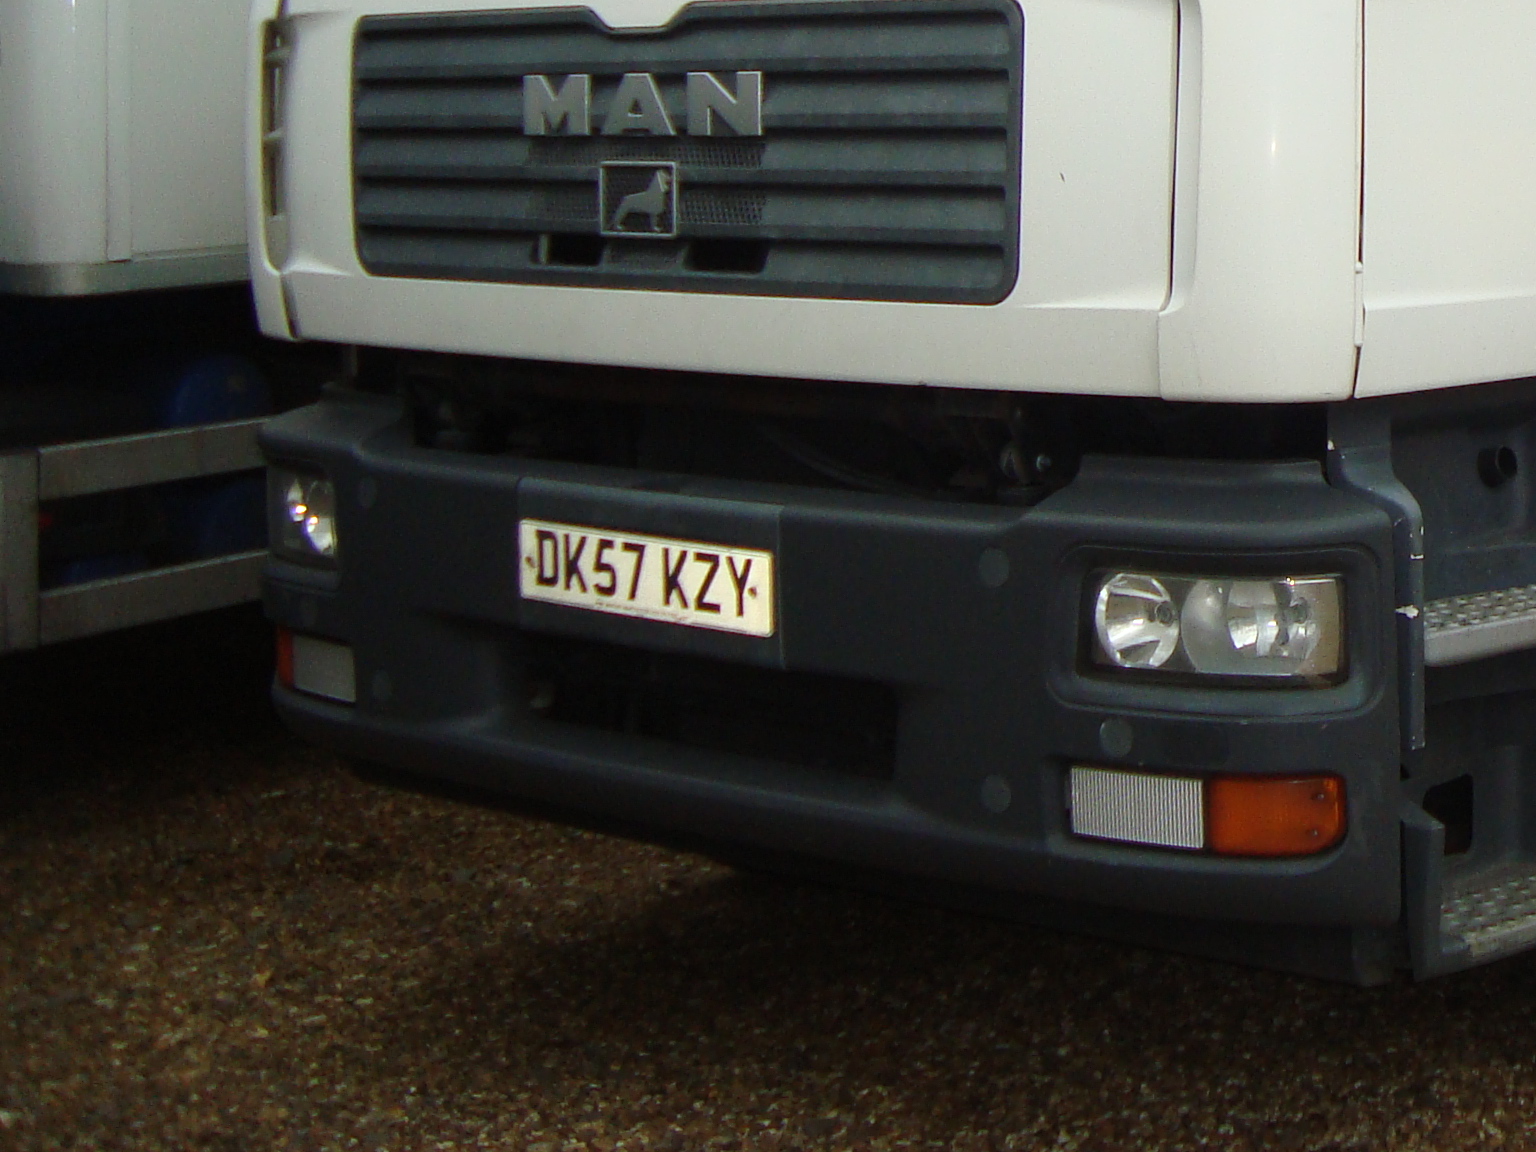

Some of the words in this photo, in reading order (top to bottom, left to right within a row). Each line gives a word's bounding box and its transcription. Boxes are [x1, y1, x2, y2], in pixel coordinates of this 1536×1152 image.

[522, 70, 763, 136] MAN
[535, 529, 647, 601] DK57
[661, 547, 753, 617] KZY
